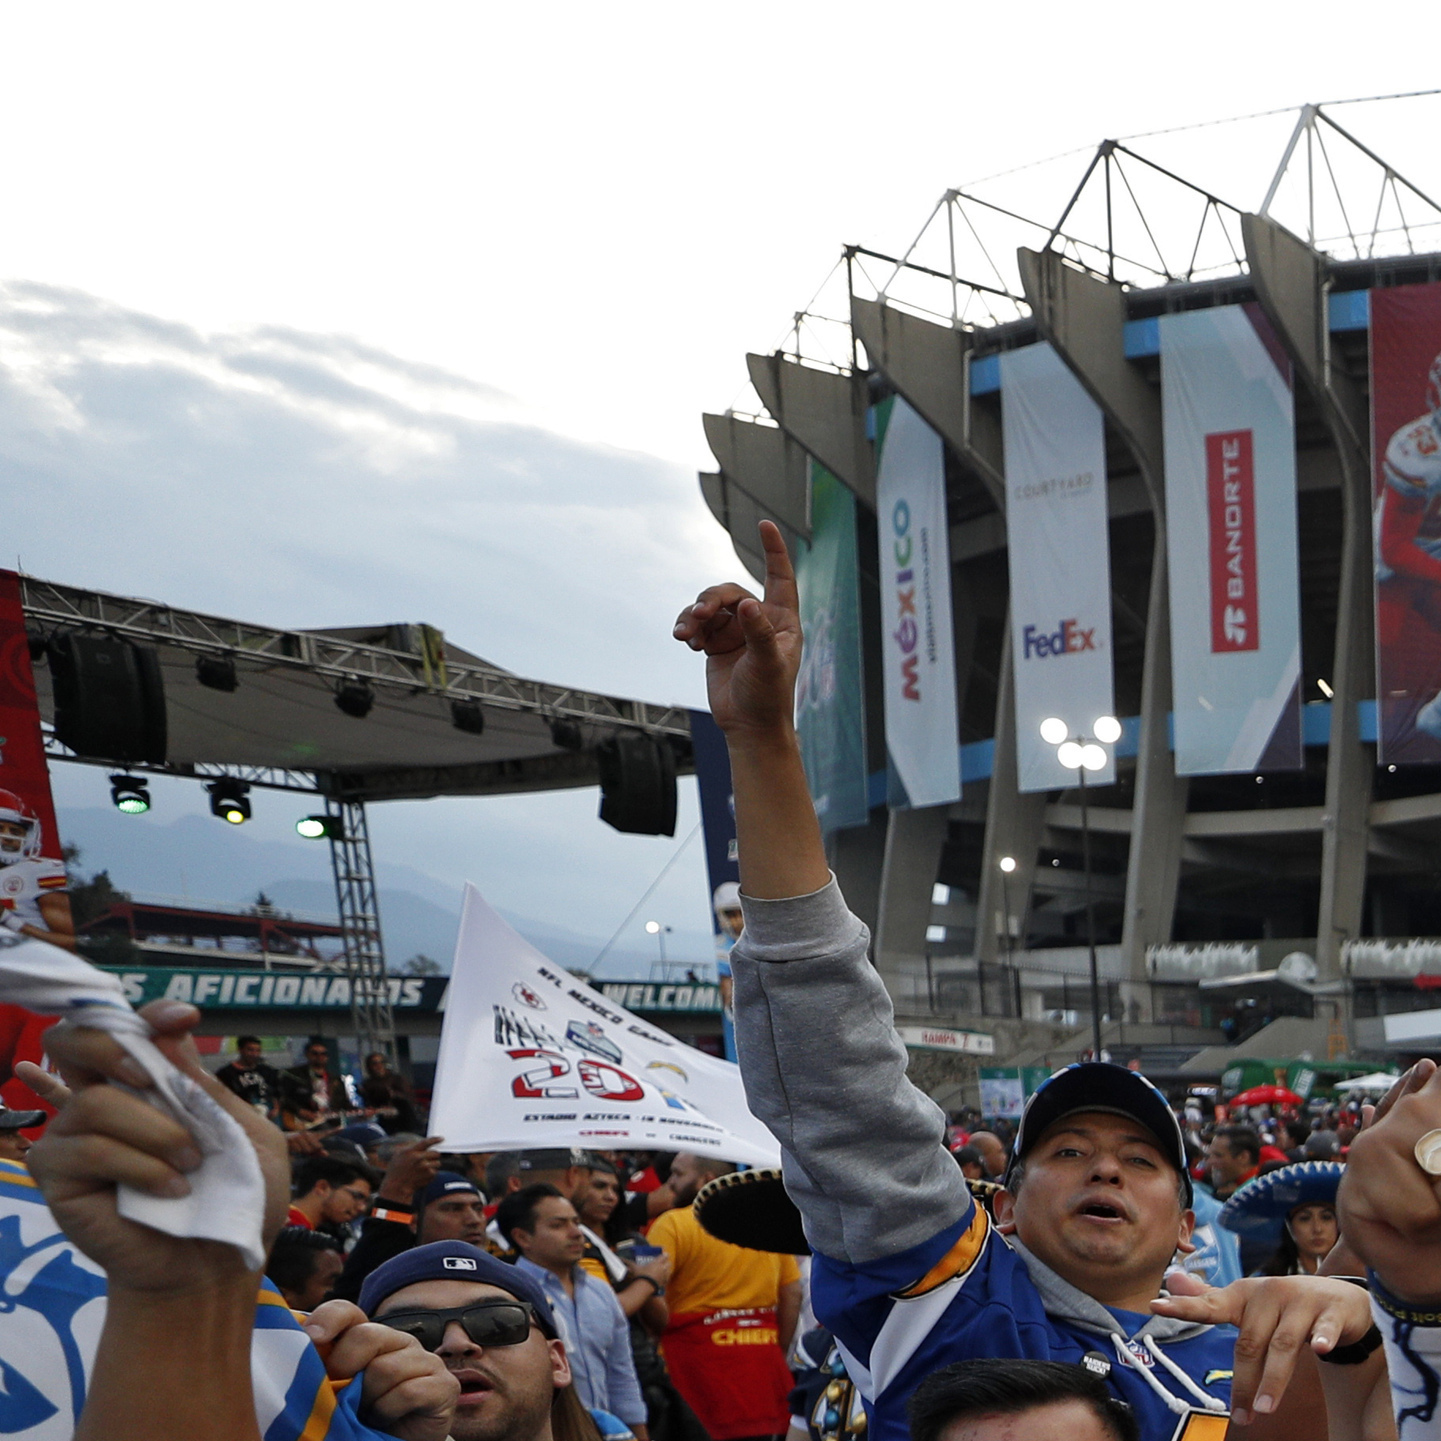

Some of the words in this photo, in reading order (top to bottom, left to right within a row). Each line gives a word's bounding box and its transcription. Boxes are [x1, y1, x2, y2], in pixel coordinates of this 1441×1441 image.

[1014, 471, 1095, 499] COURTYARD
[1222, 436, 1244, 600] BANORTE
[1022, 618, 1098, 660] FedEx
[161, 973, 427, 1007] AFICIONAOS
[566, 988, 625, 1026] MEXICO
[601, 982, 724, 1012] WELCOM
[921, 1031, 957, 1047] RAMPA
